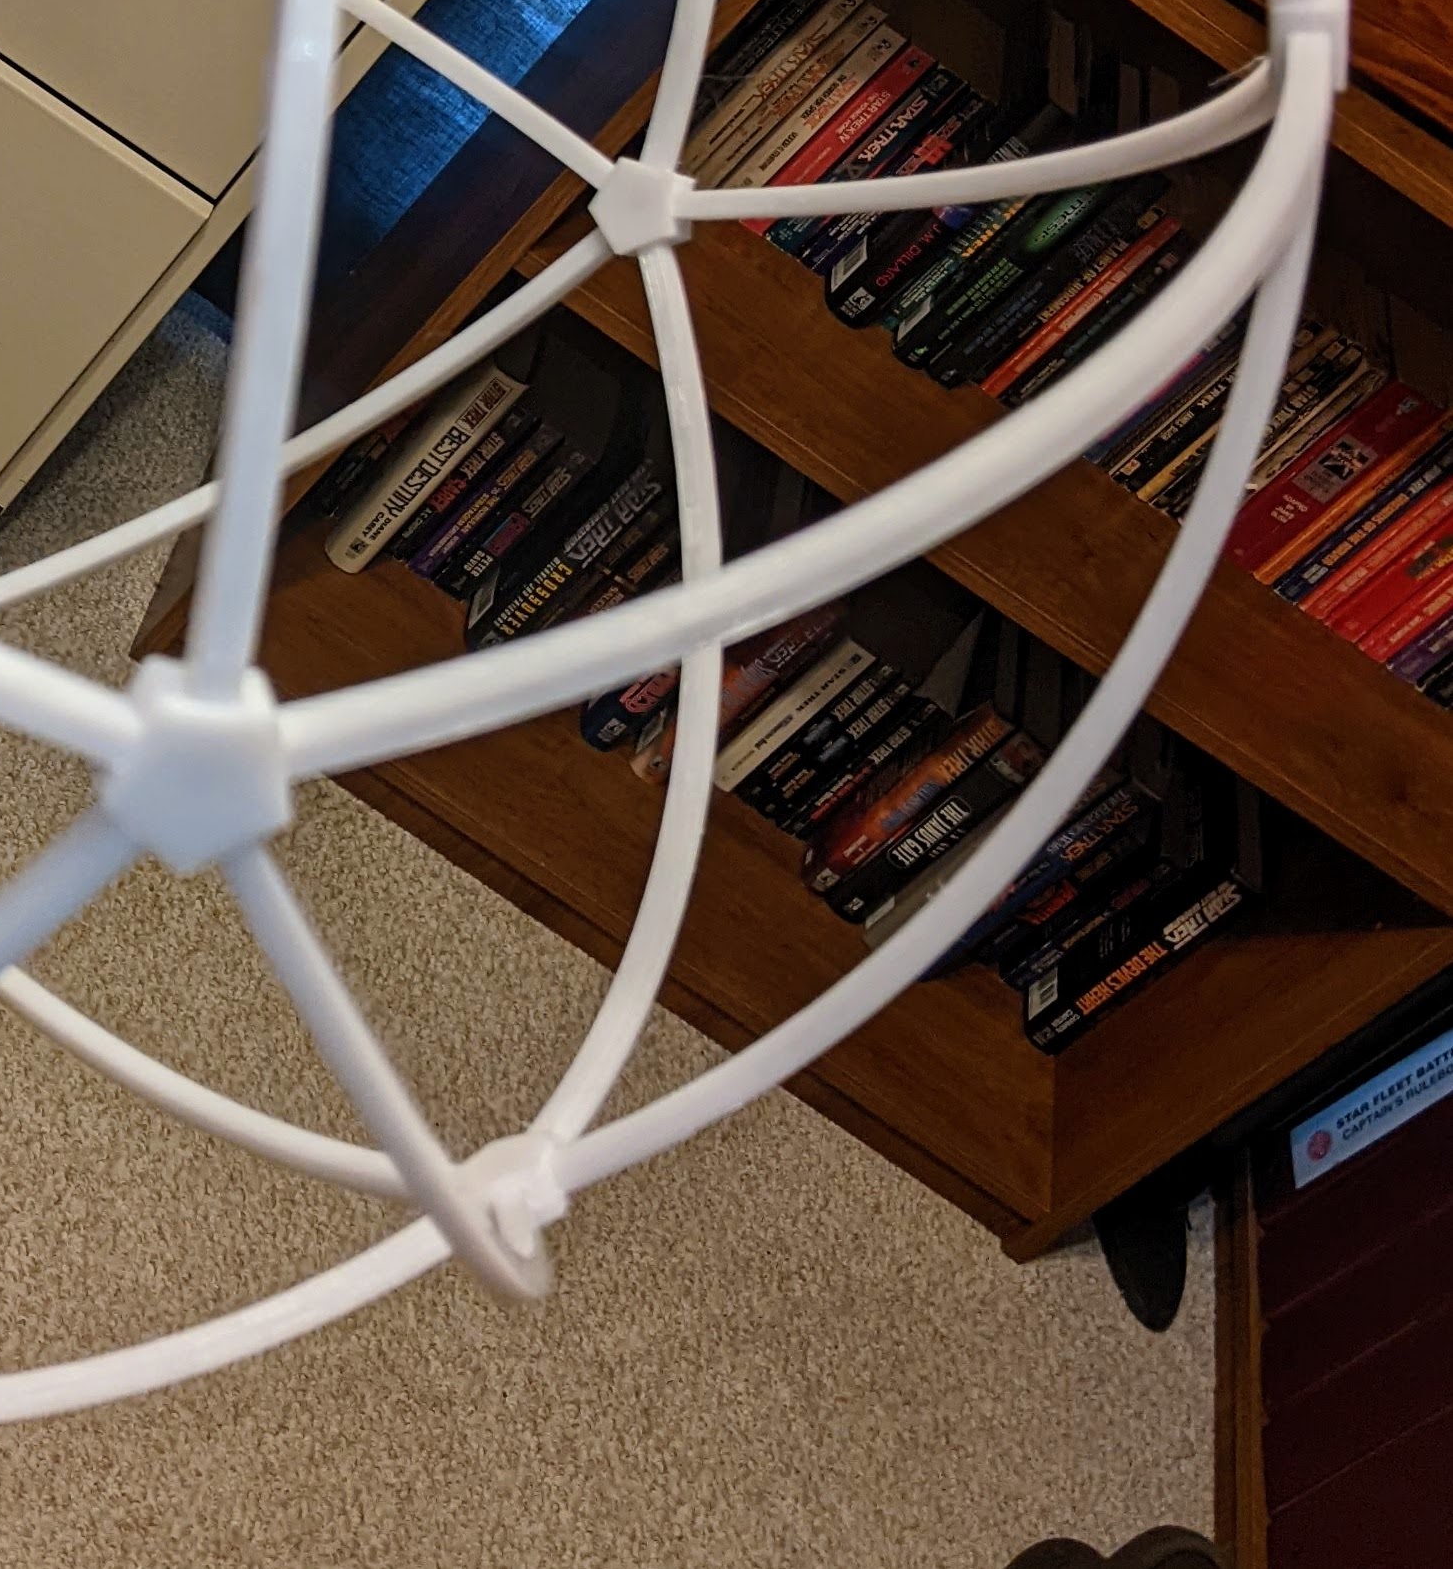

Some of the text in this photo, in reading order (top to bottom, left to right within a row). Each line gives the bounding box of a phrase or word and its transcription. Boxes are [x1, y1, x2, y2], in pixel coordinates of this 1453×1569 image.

[846, 108, 872, 134] TREK
[867, 89, 890, 114] STAR
[889, 92, 931, 131] STAR
[854, 123, 899, 166] TREK
[872, 242, 922, 289] DILLARD
[459, 379, 508, 431] STAR TREK
[380, 422, 470, 520] BEST DESTINY
[457, 430, 506, 481] STAR TREK
[610, 472, 664, 526] STAR
[359, 509, 385, 537] CAREY
[367, 515, 391, 542] DIANE
[565, 513, 624, 571] TREK
[461, 548, 485, 572] DAVID
[468, 552, 494, 578] PETER
[496, 560, 574, 638] CROSSOVER
[794, 665, 847, 714] STAR TREK
[830, 697, 855, 722] TREK
[845, 697, 891, 740] STAR TREK
[932, 745, 974, 786] TREK
[912, 810, 950, 850] JANUS
[938, 797, 968, 827] THE
[890, 834, 923, 868] GATE
[1058, 825, 1103, 865] TREK
[1163, 910, 1210, 951] TREK
[1137, 938, 1167, 966] THE
[1073, 979, 1114, 1016] HEART
[1333, 1100, 1372, 1131] STAR
[1370, 1070, 1417, 1107] FLEET
[1339, 1093, 1406, 1143] CAPTAIN'S
